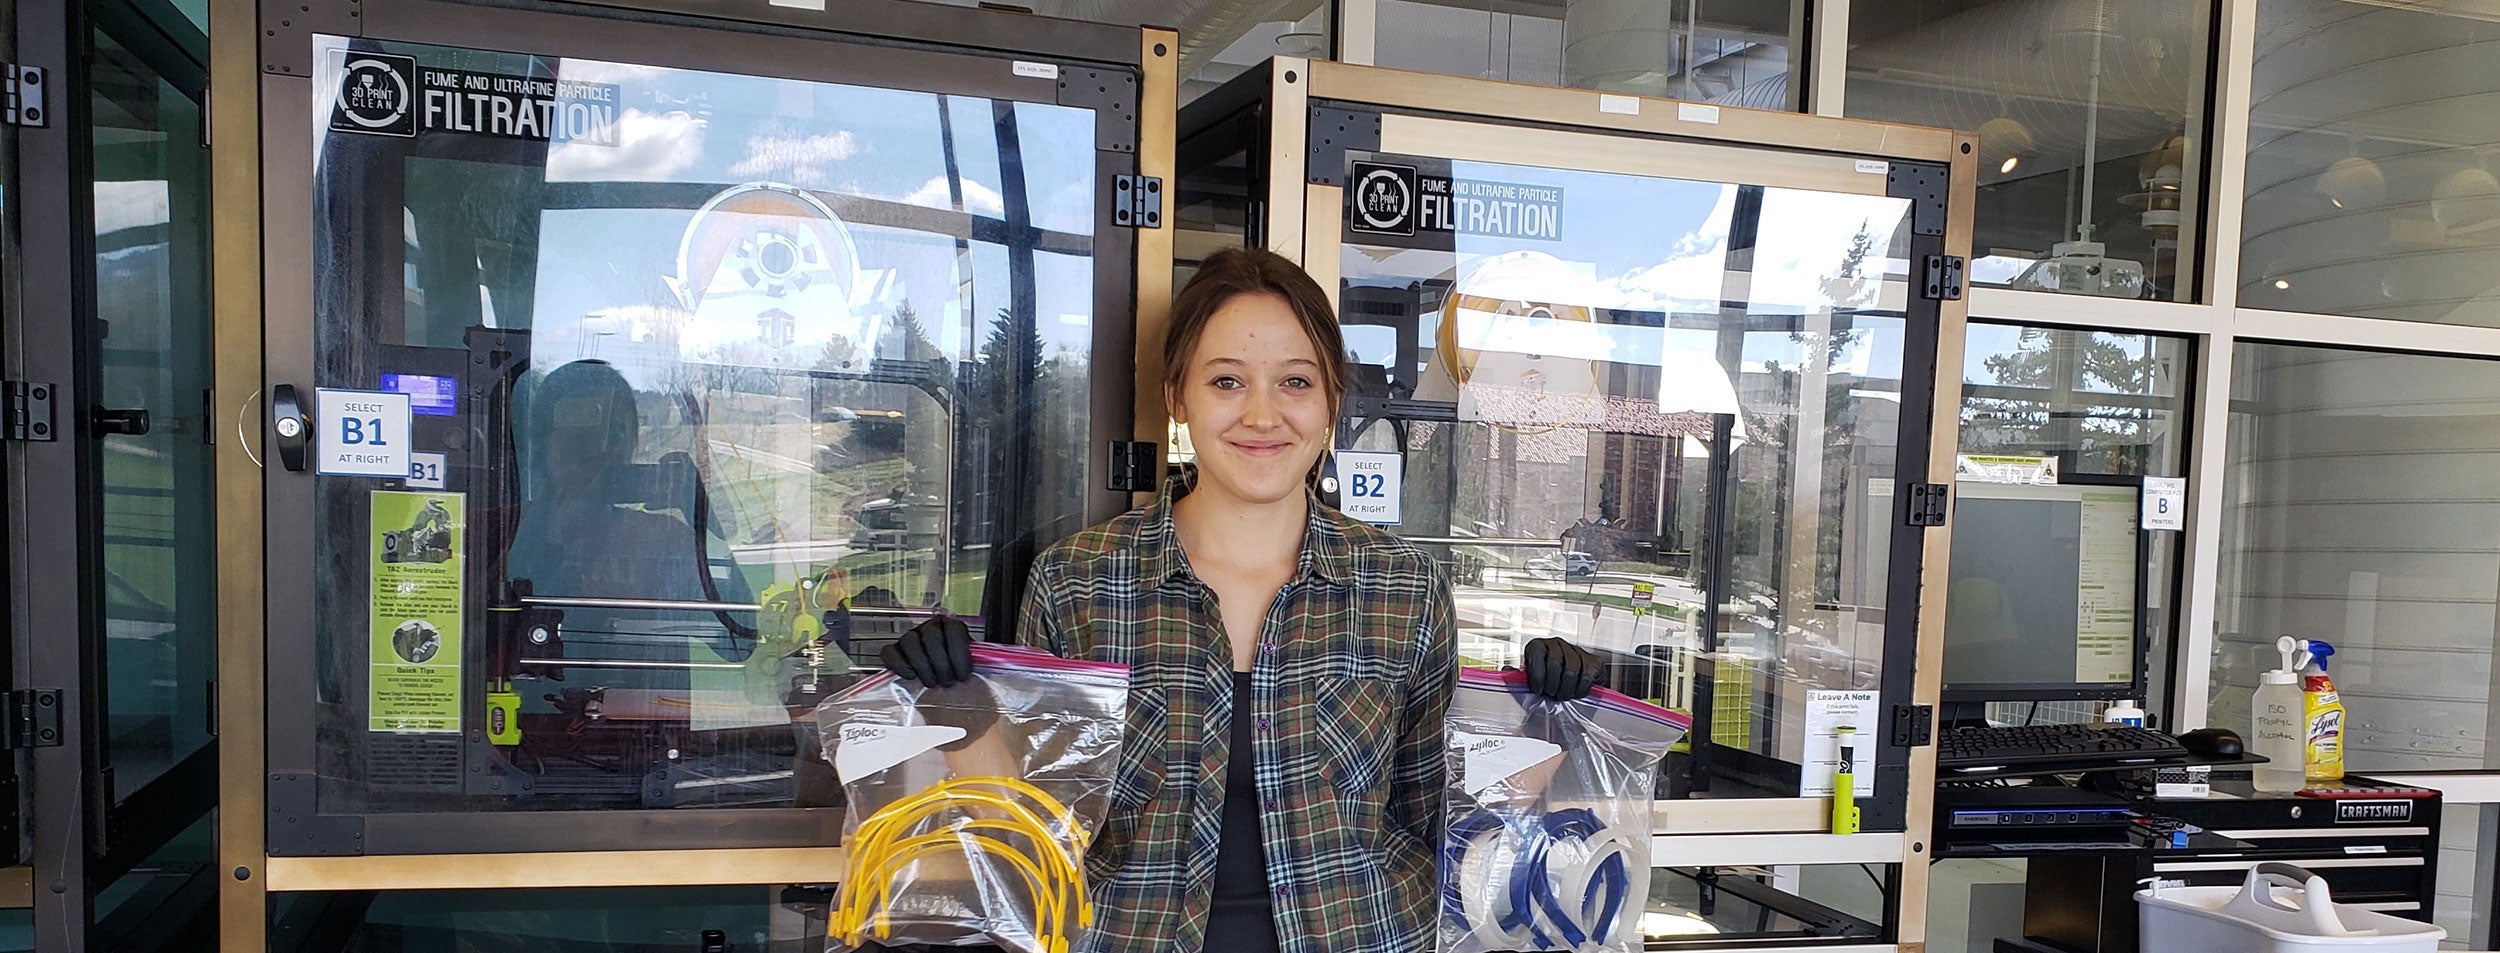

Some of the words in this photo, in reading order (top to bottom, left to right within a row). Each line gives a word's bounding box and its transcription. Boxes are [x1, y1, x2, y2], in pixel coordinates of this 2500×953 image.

[351, 86, 366, 97] 3D
[368, 87, 393, 101] PRINT
[425, 71, 460, 89] FUME
[464, 74, 489, 91] AND
[494, 77, 554, 97] ULTRAFINE
[559, 83, 612, 102] PARTICLE
[352, 98, 393, 110] CLEAN
[425, 89, 612, 144] FILTRATION
[1422, 178, 1447, 193] FUME
[1450, 182, 1469, 195] AND
[1472, 183, 1516, 199] ULTRAFINE
[1519, 187, 1557, 203] PARTICLE
[1368, 202, 1398, 214] CLEAN
[1420, 194, 1557, 239] FILTRATION
[344, 402, 384, 413] SELECT
[341, 416, 387, 446] B1
[338, 454, 352, 464] AT
[355, 454, 390, 465] RIGHT
[1354, 461, 1383, 470] SELECT
[411, 462, 440, 482] B1
[1352, 473, 1385, 498] B2
[1349, 505, 1359, 513] AT
[1361, 505, 1386, 514] RIGHT
[2159, 498, 2168, 514] B
[419, 667, 435, 675] Tips
[1817, 693, 1841, 701] Leave
[1843, 693, 1850, 701] A
[1852, 693, 1871, 701] Note
[2311, 713, 2340, 734] Lysol
[2341, 804, 2408, 818] CRAFTSMAN
